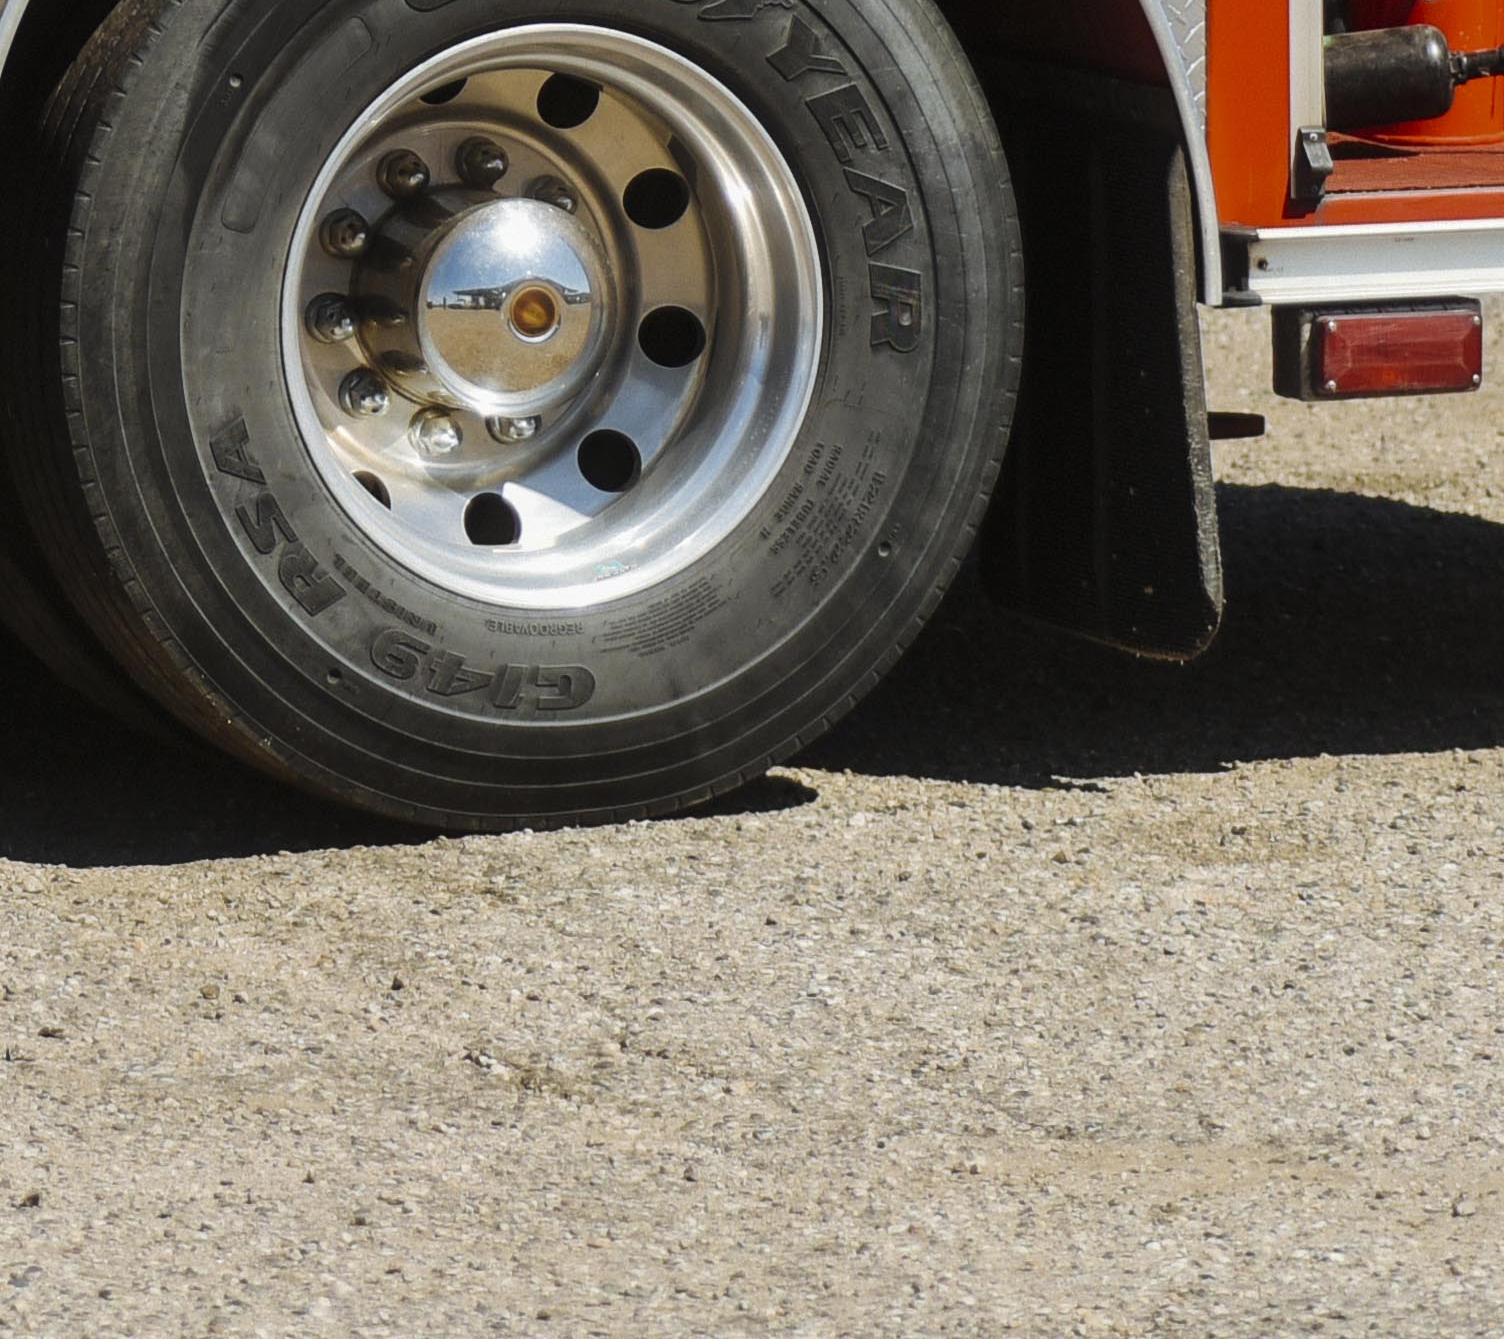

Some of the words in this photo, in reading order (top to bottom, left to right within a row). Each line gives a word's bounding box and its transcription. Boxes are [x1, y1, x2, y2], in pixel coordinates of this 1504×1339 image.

[209, 417, 347, 617] RSA
[334, 553, 438, 635] UNISTEEL
[370, 629, 596, 711] G149
